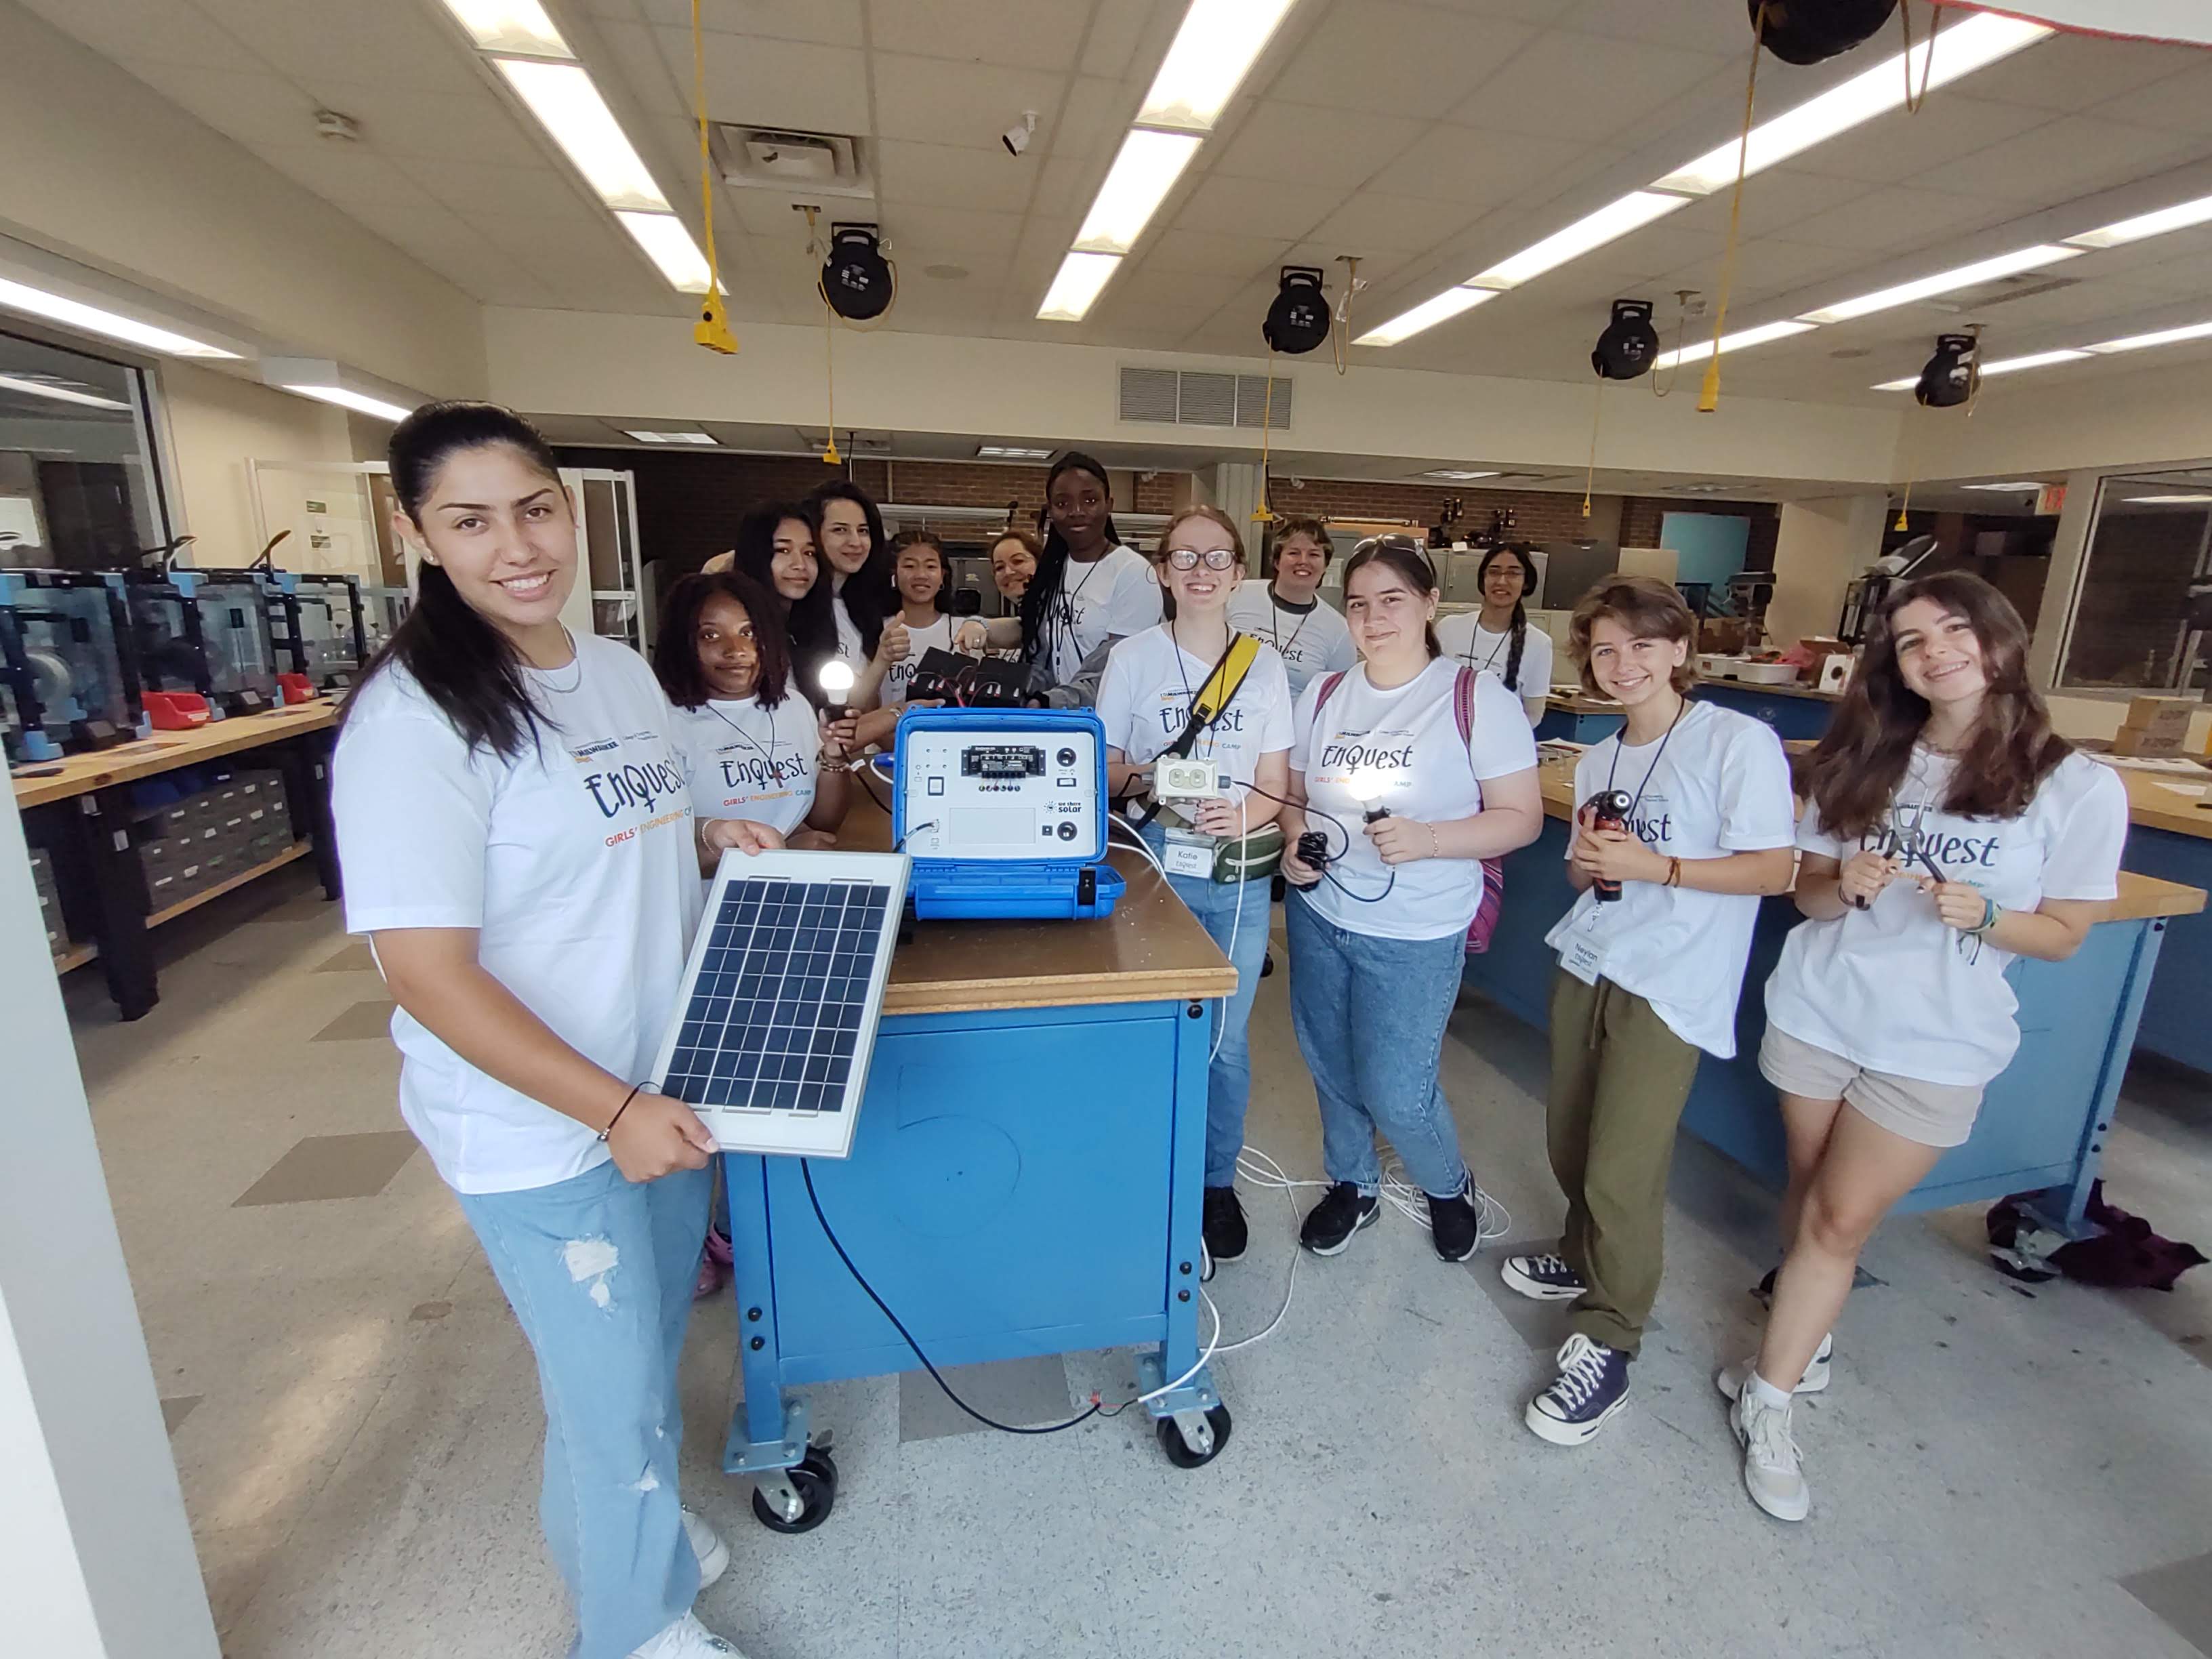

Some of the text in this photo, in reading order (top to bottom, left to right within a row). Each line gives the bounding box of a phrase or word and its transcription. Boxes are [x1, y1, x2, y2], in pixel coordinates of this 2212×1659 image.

[1159, 707, 1244, 733] Enst
[719, 753, 808, 791] EnQuest
[1322, 745, 1414, 775] EnQuest
[583, 752, 686, 819] EnQuest
[605, 827, 638, 847] GIRLS'
[640, 808, 684, 834] ENGINEERING
[1177, 851, 1198, 861] Katie
